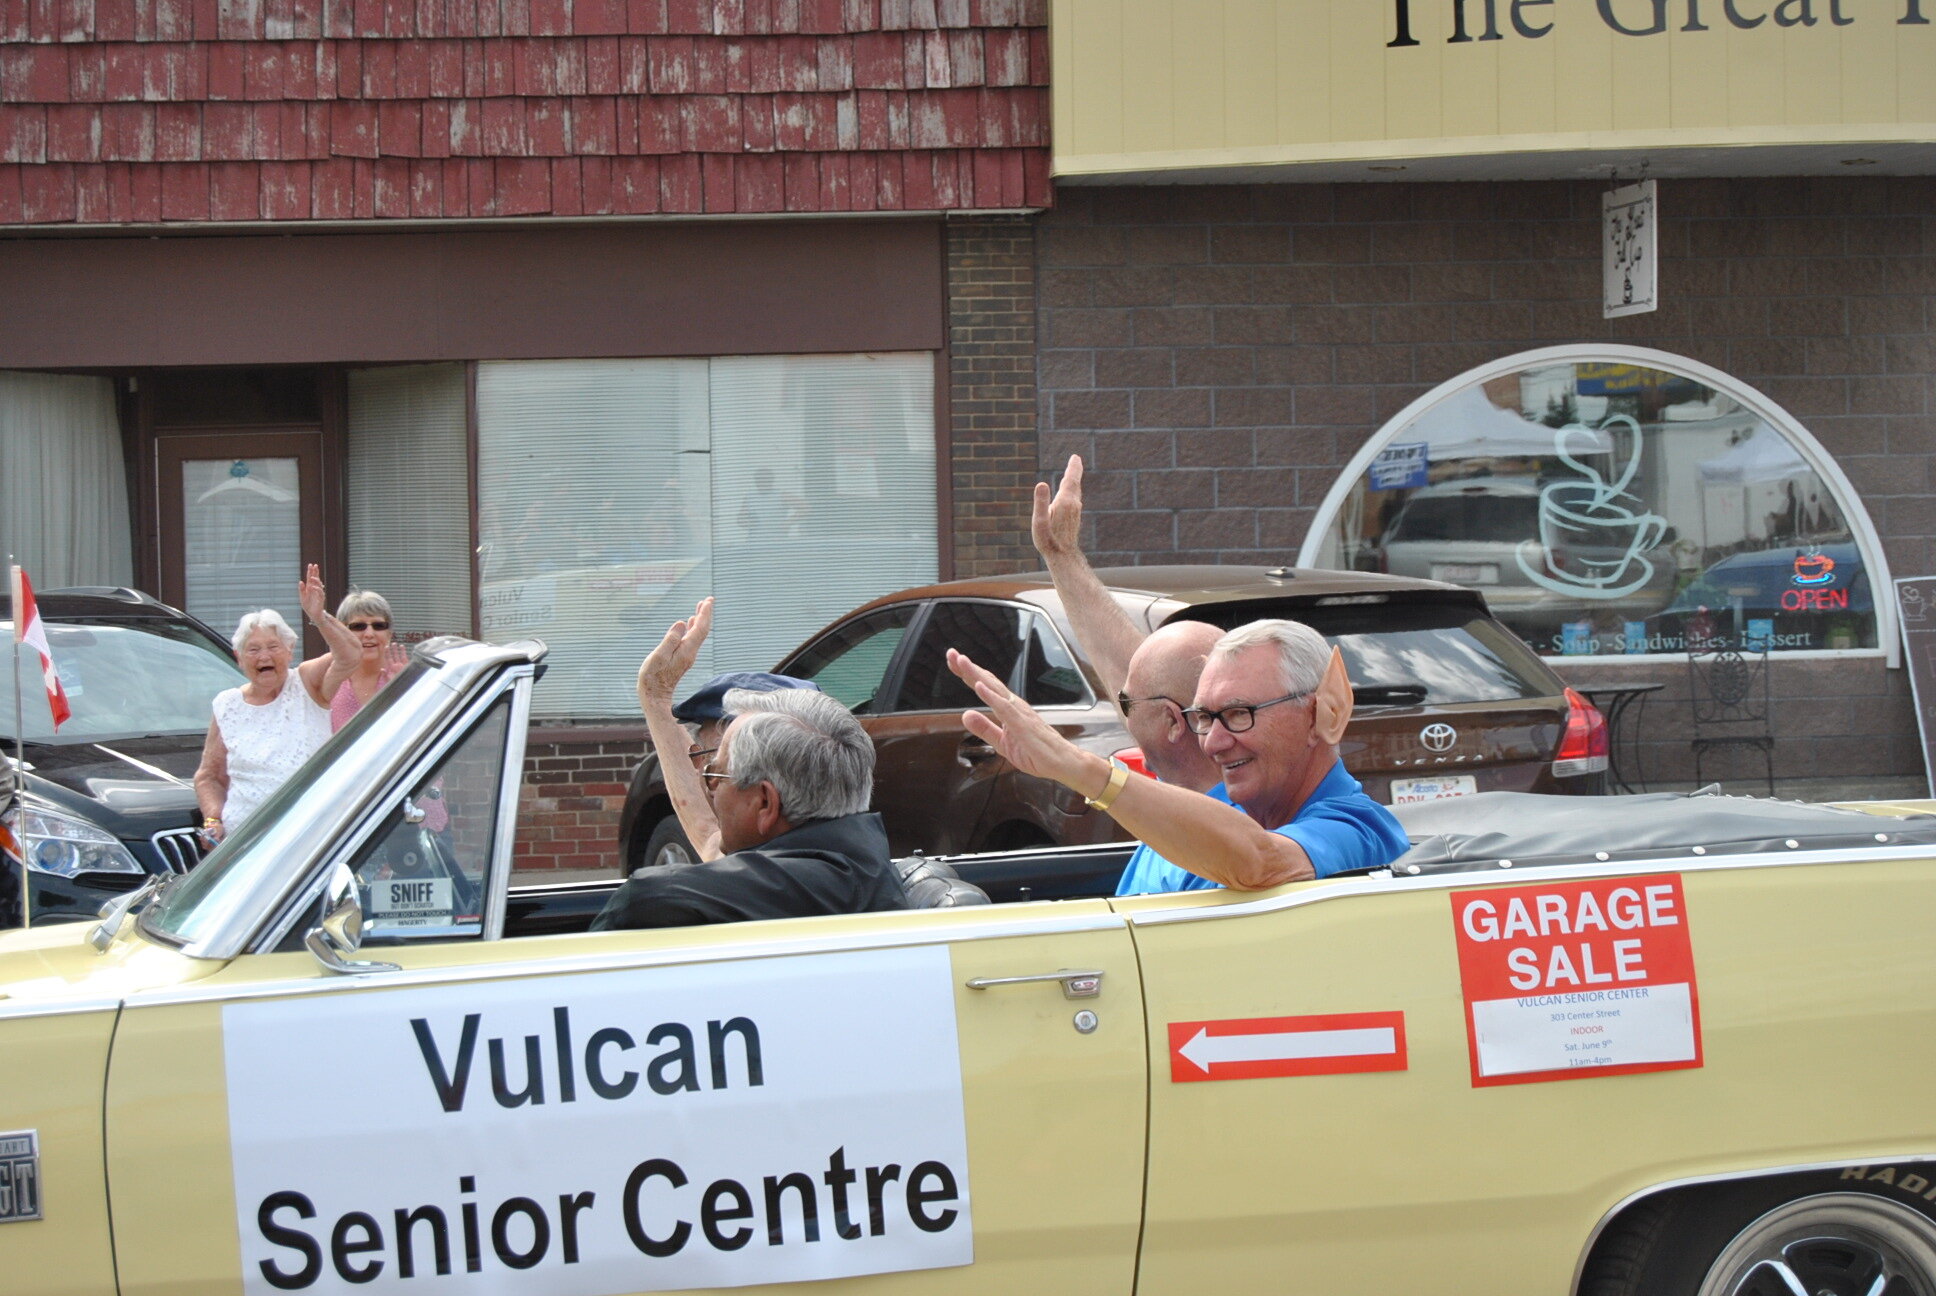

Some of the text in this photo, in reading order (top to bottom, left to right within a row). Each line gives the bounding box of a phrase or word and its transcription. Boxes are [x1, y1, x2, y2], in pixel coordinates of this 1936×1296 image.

[1781, 588, 1849, 611] OPEN
[391, 882, 433, 903] SNIFF
[1462, 884, 1678, 942] GARAGE
[1507, 938, 1648, 991] SALE
[1517, 987, 1649, 1008] VULCAN SENIOR CENTER
[1550, 1009, 1621, 1021] 303 Center Street
[1570, 1025, 1604, 1036] INDOOR
[1564, 1042, 1579, 1051] Sat.
[1582, 1041, 1600, 1050] June
[410, 1005, 765, 1113] Vulcan
[1569, 1057, 1613, 1066] 11am-4pm
[0, 1139, 26, 1155] ART
[257, 1145, 960, 1291] Senior Centre
